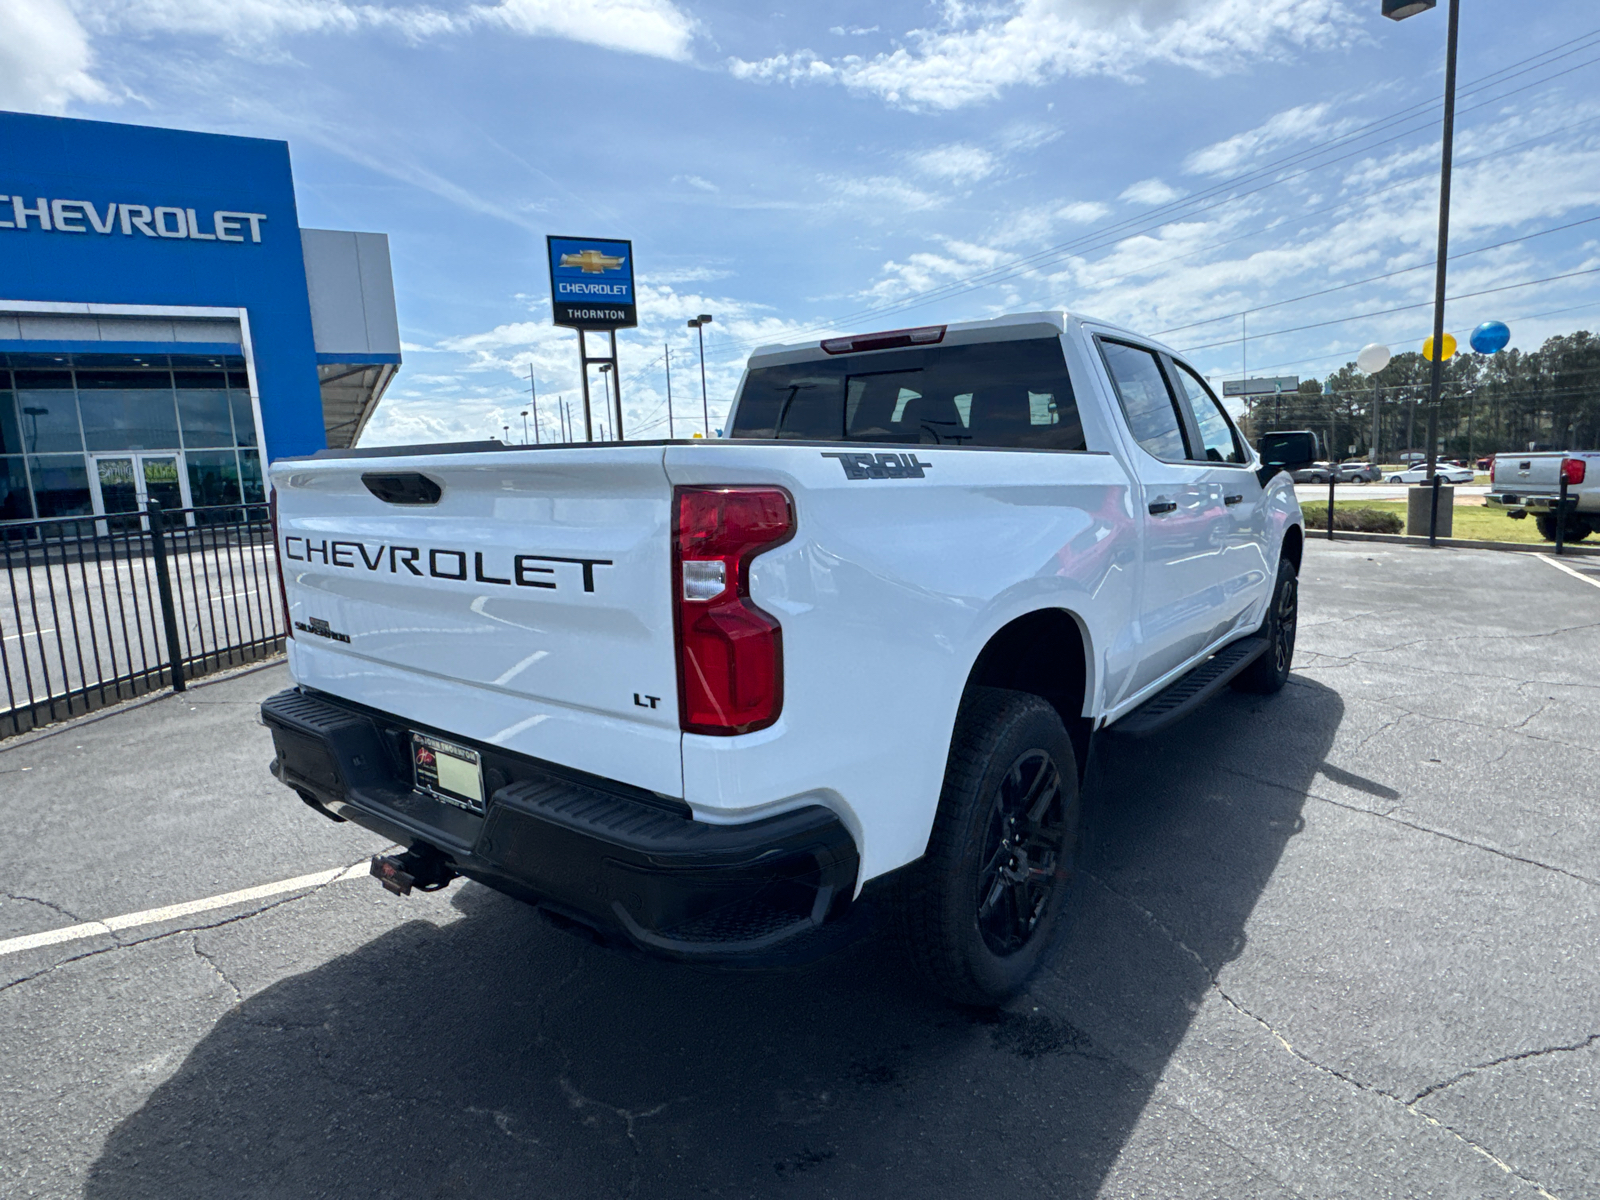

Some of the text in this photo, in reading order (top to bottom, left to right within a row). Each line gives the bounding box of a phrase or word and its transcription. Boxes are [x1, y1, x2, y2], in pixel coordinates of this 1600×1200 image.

[559, 283, 627, 295] CHEVROLET
[567, 309, 625, 319] THORNTON
[285, 537, 613, 592] CHEVROLET
[633, 693, 661, 709] LT
